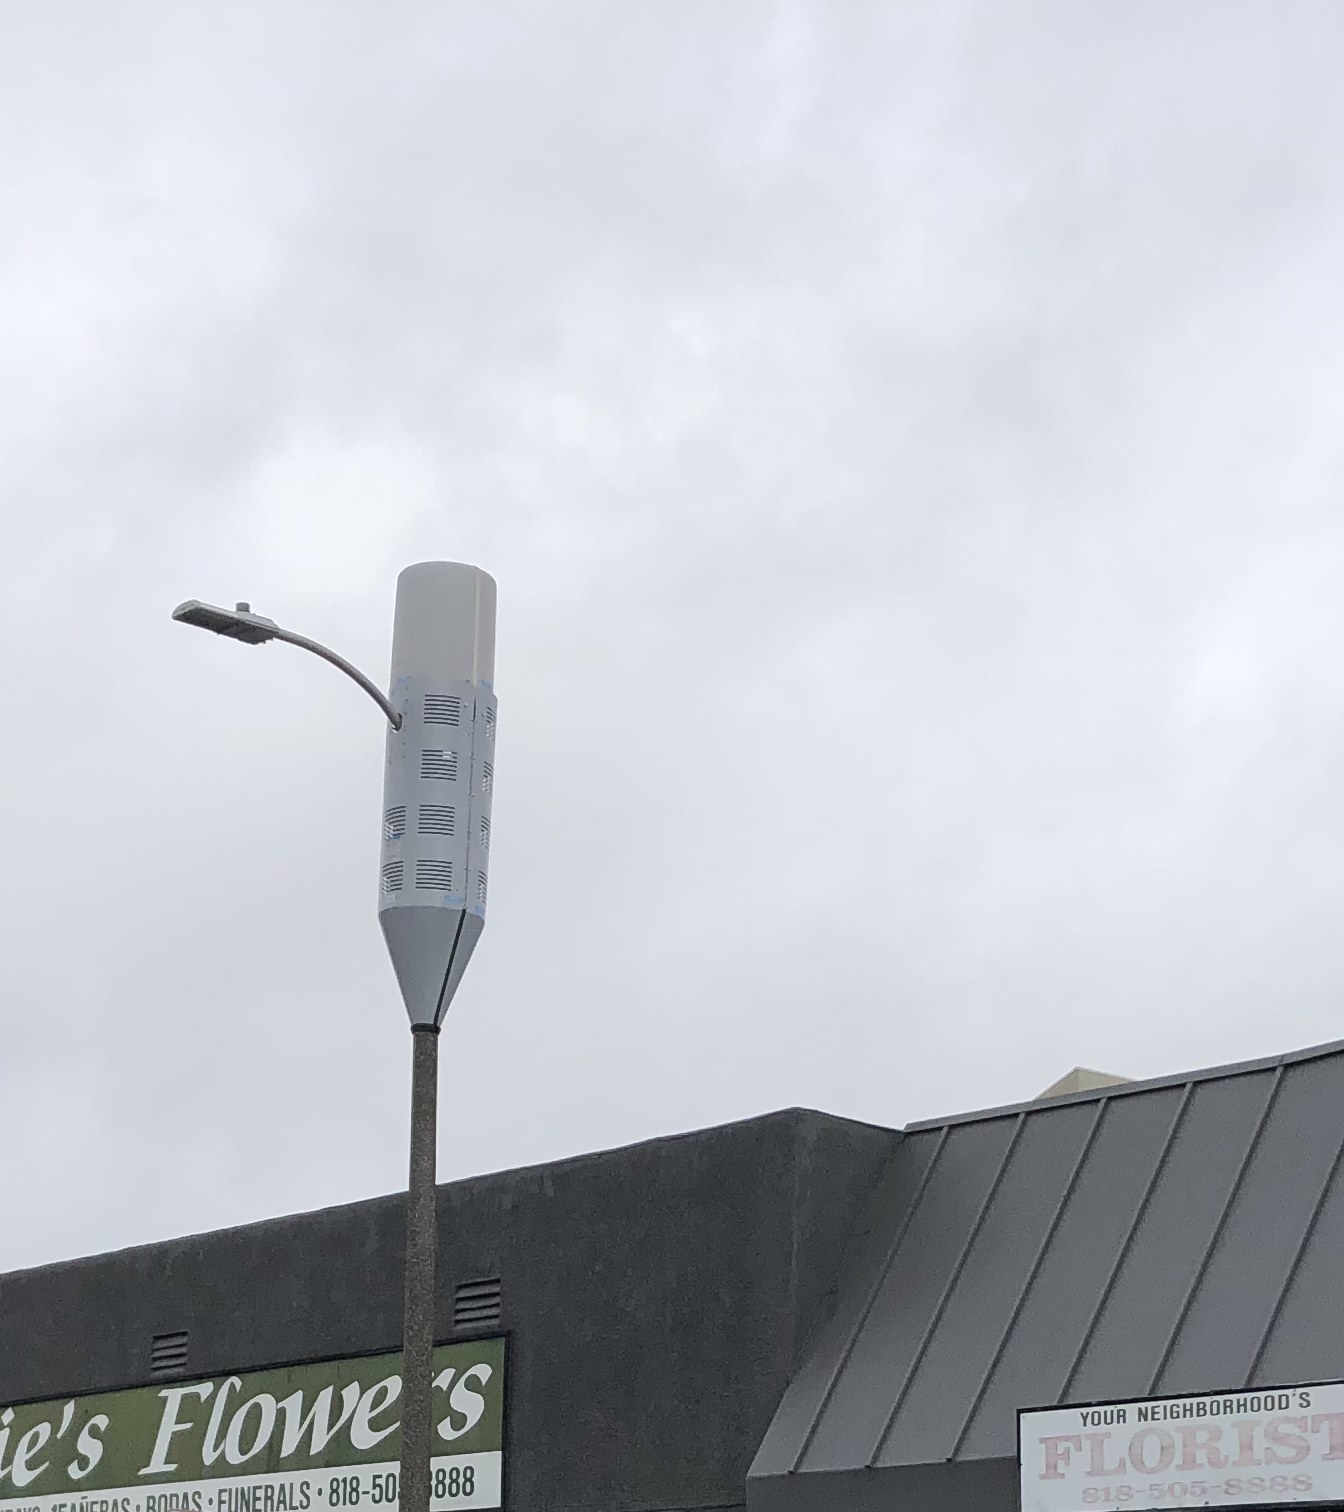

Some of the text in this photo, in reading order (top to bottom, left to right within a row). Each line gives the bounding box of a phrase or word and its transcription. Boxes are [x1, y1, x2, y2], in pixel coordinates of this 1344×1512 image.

[1079, 1391, 1313, 1427] YOUR NEIGHBORHOOD'S
[328, 1465, 476, 1508] 818-50888
[1080, 1474, 1314, 1505] 818-505-8888
